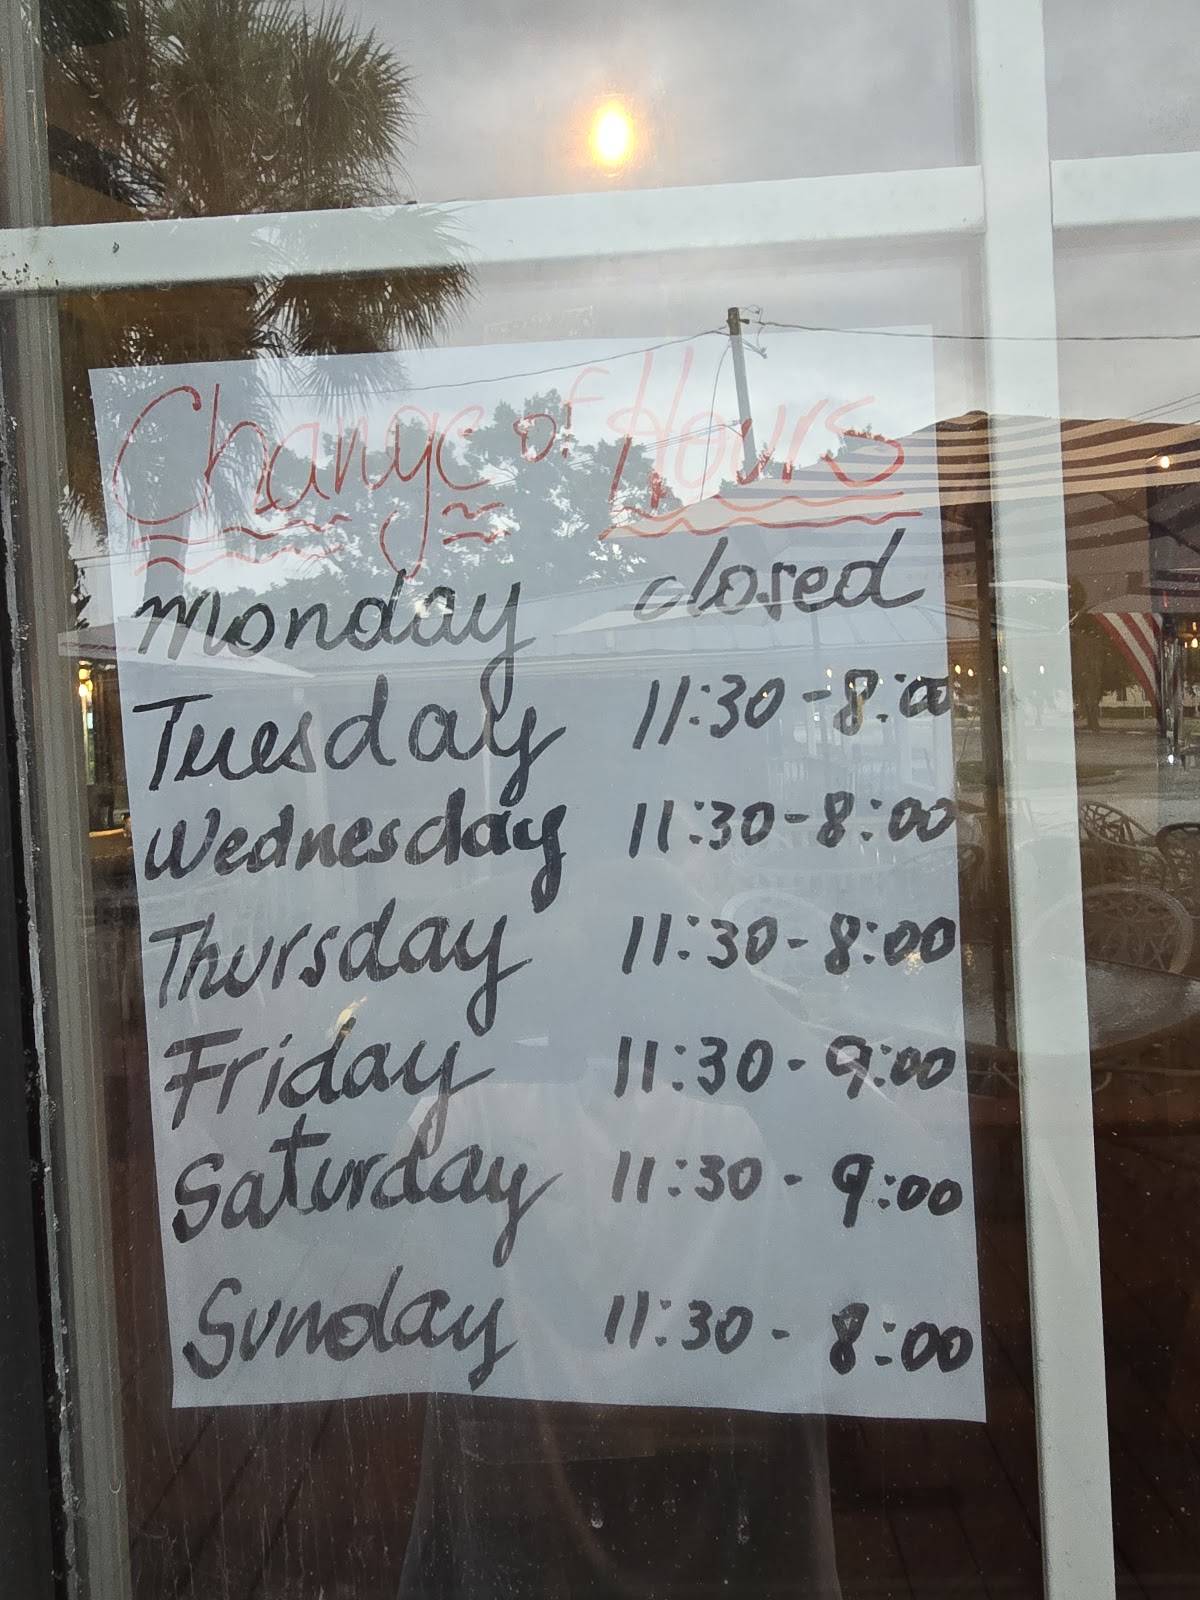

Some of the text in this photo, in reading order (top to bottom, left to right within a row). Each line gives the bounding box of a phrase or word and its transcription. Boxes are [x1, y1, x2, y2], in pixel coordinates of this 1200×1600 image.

[113, 383, 494, 580] Change
[606, 346, 905, 509] Hours
[132, 568, 537, 717] Monday
[132, 673, 567, 807] Tuesday
[143, 787, 568, 914] Wednesday
[148, 897, 533, 1037] Thursday
[163, 1016, 496, 1158] Friday
[171, 1113, 564, 1268] Saturday
[182, 1265, 519, 1391] Sunday
